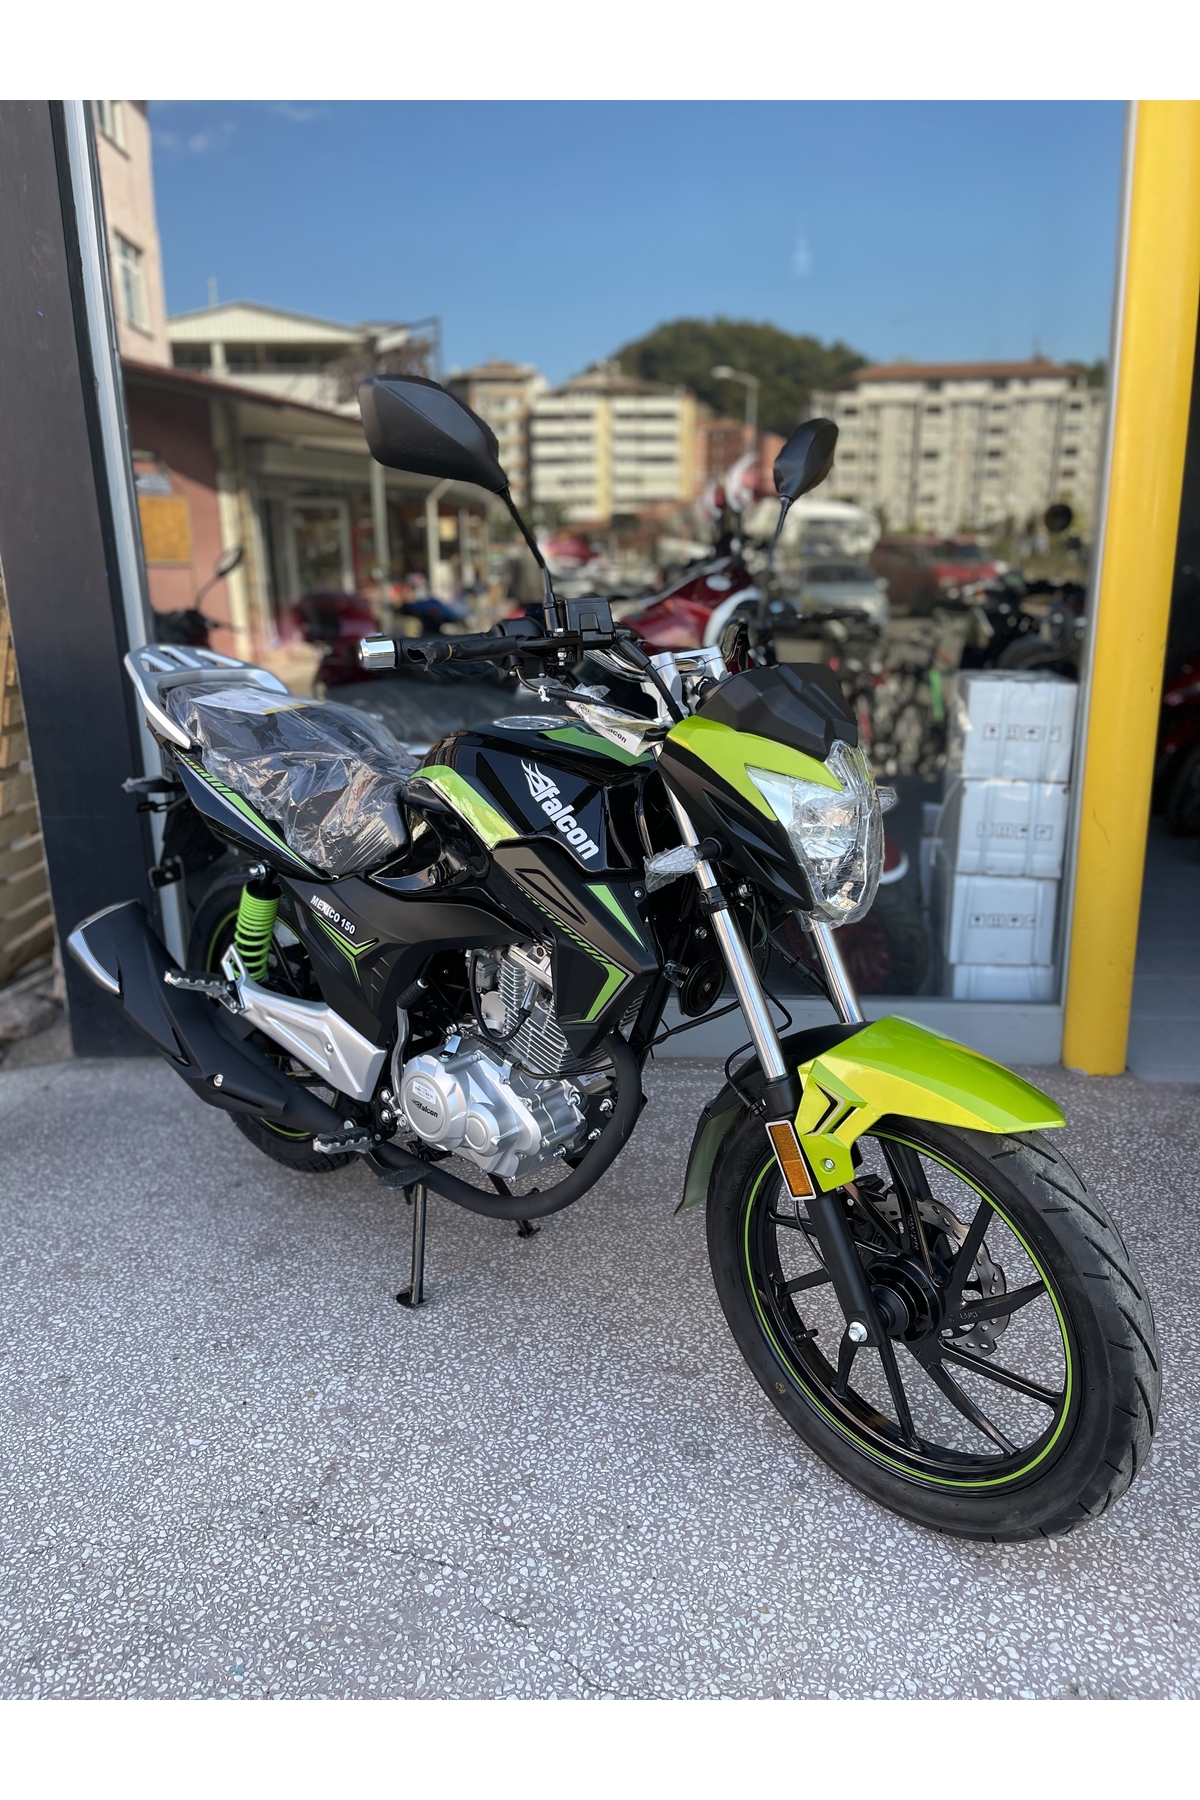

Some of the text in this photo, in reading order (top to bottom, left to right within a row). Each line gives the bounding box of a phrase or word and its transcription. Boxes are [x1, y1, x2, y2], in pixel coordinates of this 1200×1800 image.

[605, 728, 627, 744] lcon
[533, 785, 600, 861] falcon
[310, 895, 356, 935] MEXICO 150
[416, 1101, 439, 1118] falcon
